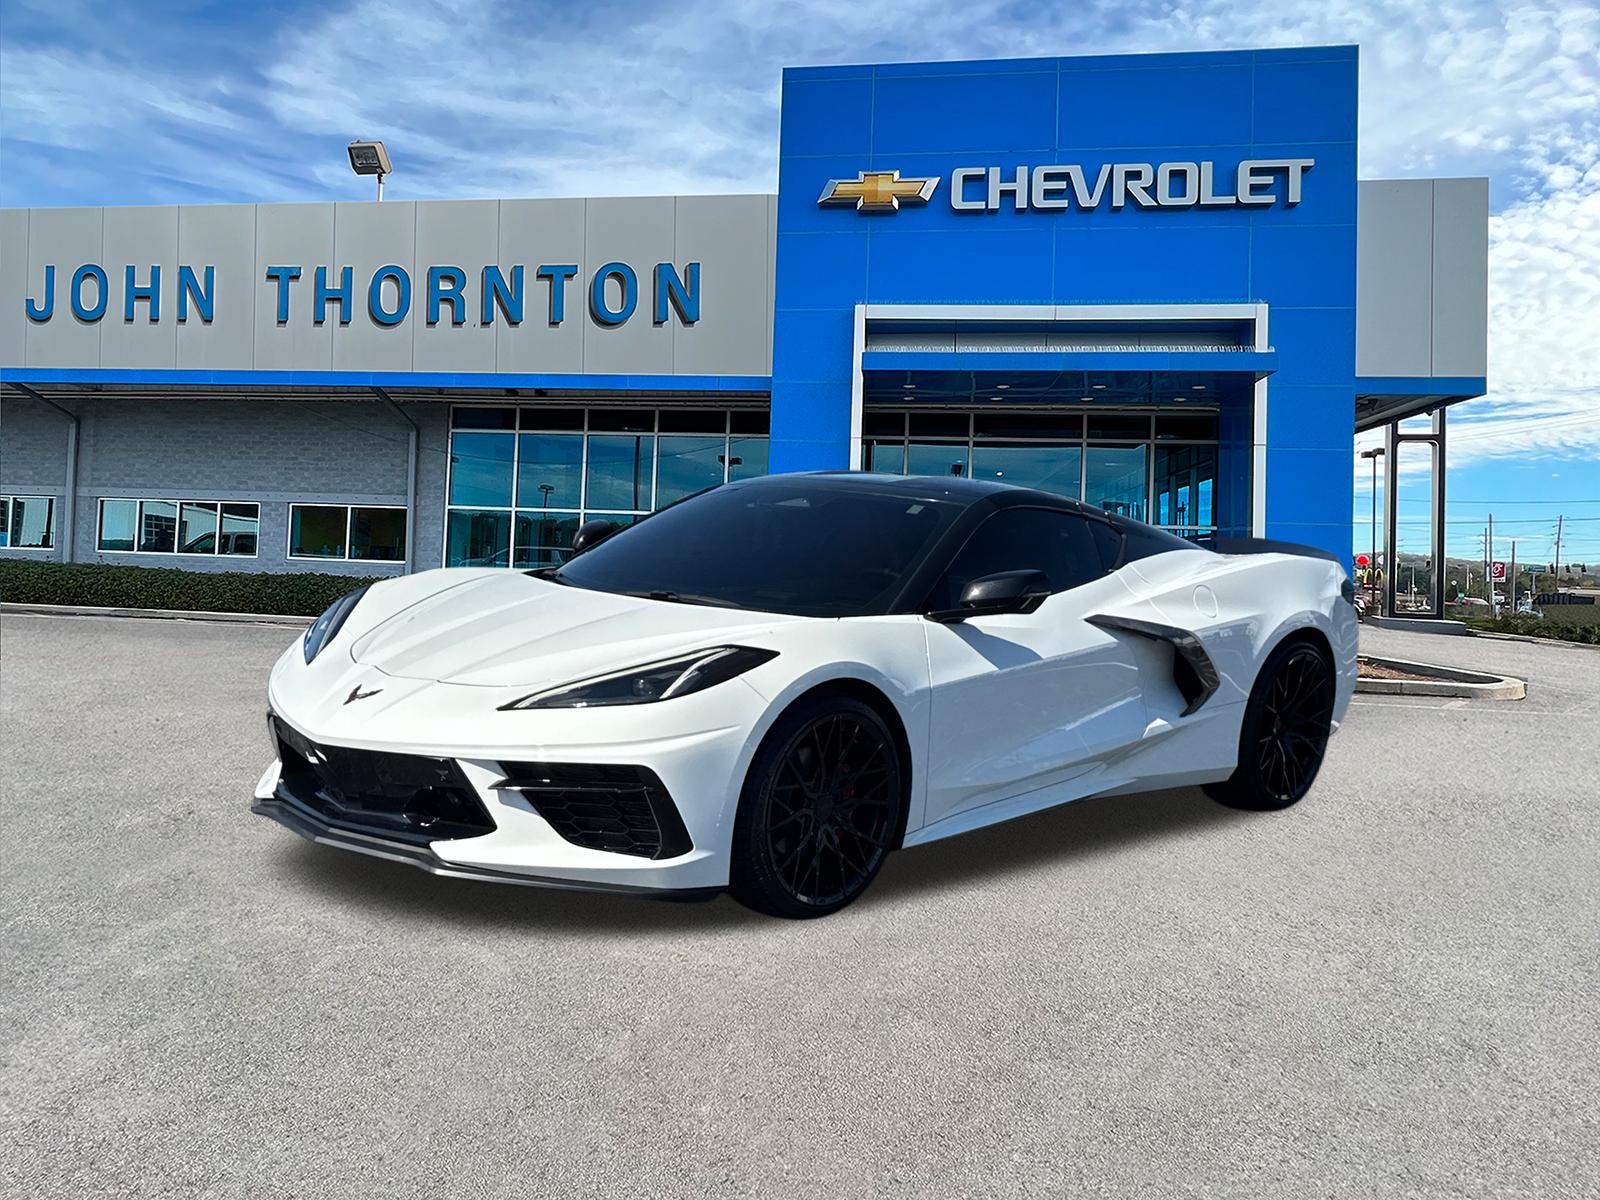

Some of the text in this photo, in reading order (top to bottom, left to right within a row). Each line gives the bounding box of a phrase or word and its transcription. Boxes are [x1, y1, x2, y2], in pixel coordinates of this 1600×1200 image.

[951, 158, 1316, 213] CHEVROLET
[25, 262, 701, 328] JOHN THORNTON
